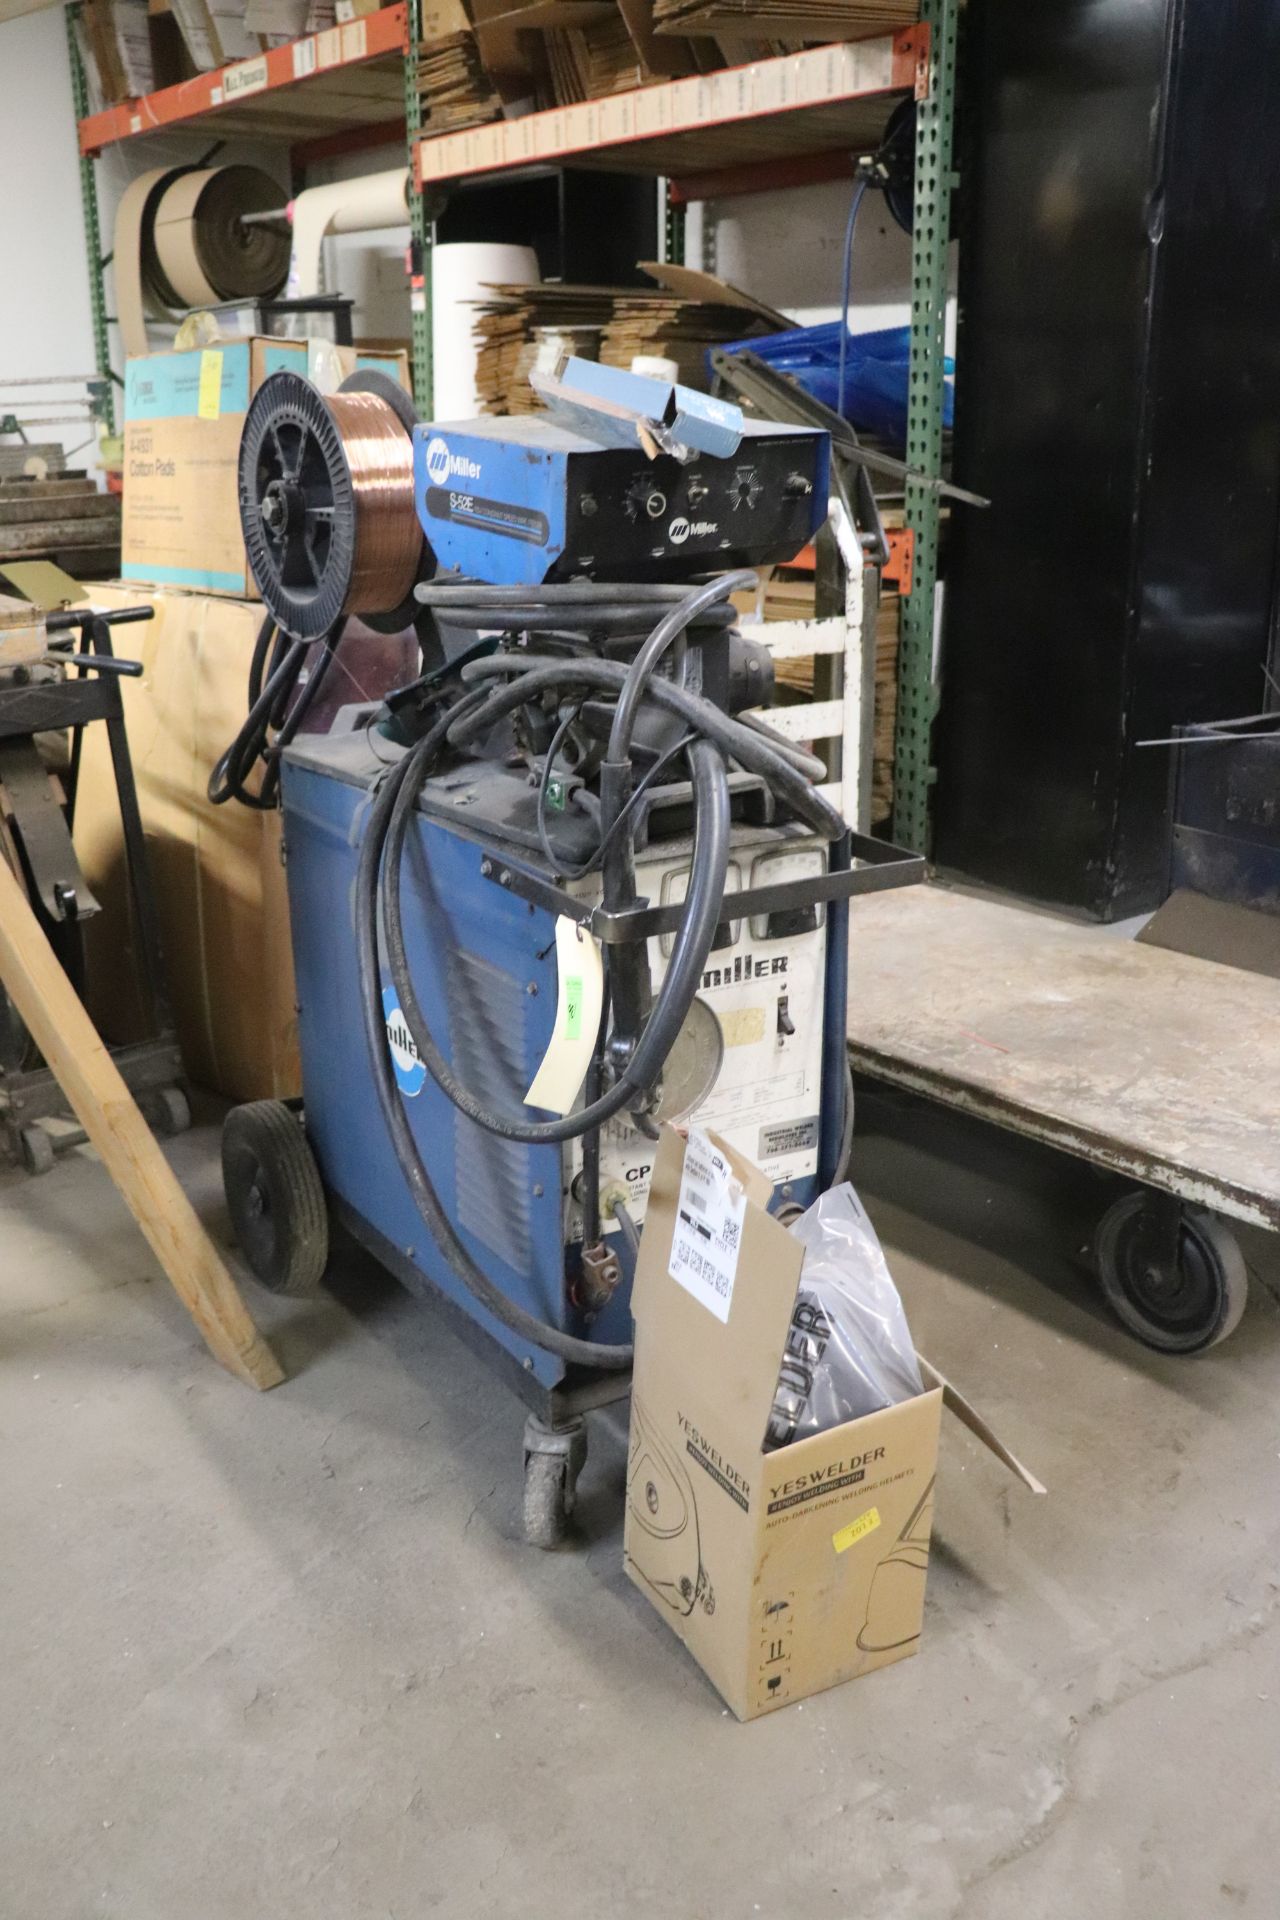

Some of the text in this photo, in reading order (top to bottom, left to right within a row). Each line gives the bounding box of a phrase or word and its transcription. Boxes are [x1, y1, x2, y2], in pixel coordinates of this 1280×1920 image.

[129, 459, 154, 477] Cotton
[155, 457, 176, 477] Pads
[449, 454, 482, 479] Miller
[449, 492, 475, 513] S-52E
[690, 522, 718, 537] Miller
[625, 1165, 651, 1182] CP
[677, 1411, 751, 1498] YESWELDER
[769, 1446, 886, 1499] YESWELDER
[765, 1498, 841, 1529] AUTO-DARKENING
[841, 1483, 880, 1502] WELDING
[879, 1467, 916, 1488] HELMETS
[802, 1478, 840, 1501] WELDING
[839, 1471, 864, 1487] WITH
